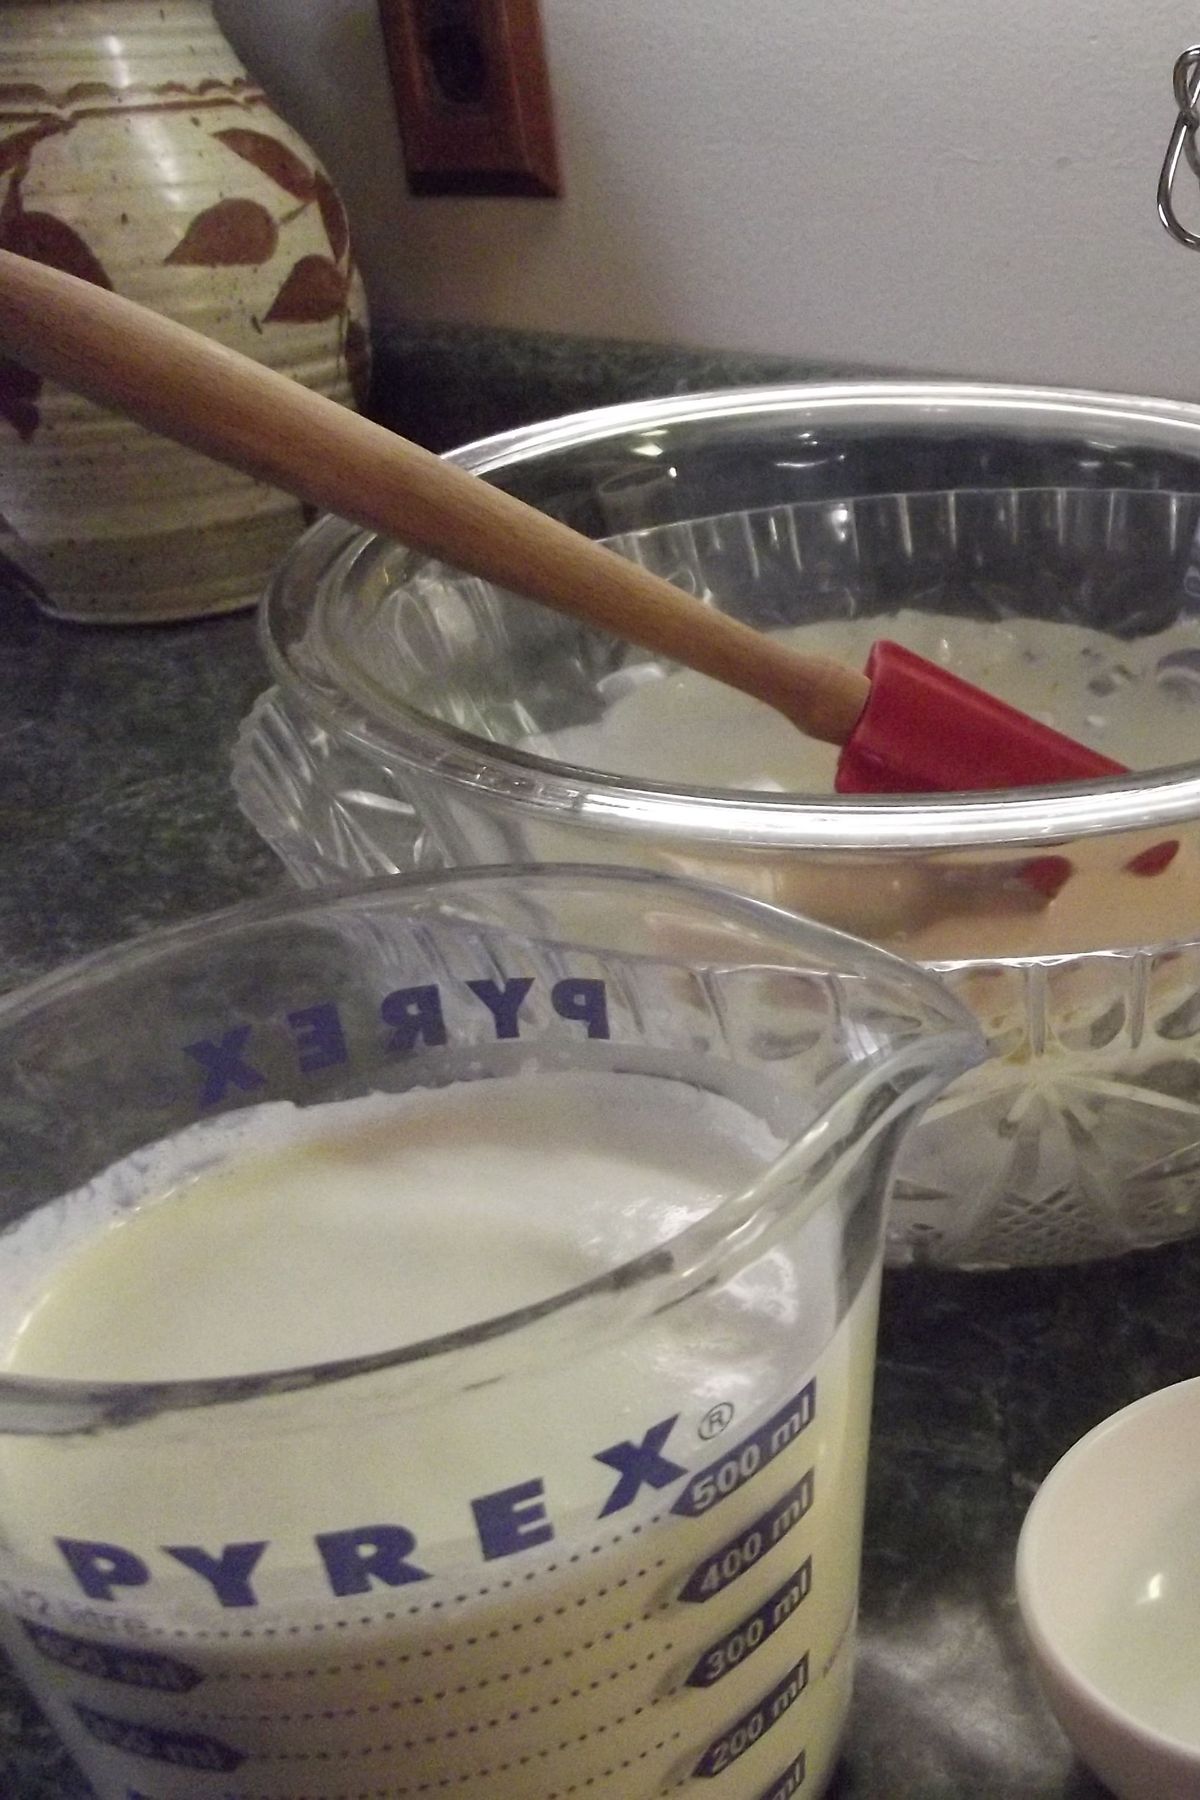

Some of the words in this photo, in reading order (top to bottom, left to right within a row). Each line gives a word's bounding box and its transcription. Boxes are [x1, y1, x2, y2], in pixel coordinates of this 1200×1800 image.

[692, 1443, 761, 1511] 500
[771, 1395, 811, 1452] ml
[55, 1413, 688, 1608] PYREX
[700, 1531, 763, 1592] 400
[772, 1481, 810, 1542] ml
[705, 1617, 765, 1681] 300
[773, 1567, 808, 1625] ml
[710, 1712, 765, 1775] 200
[772, 1662, 806, 1718] ml
